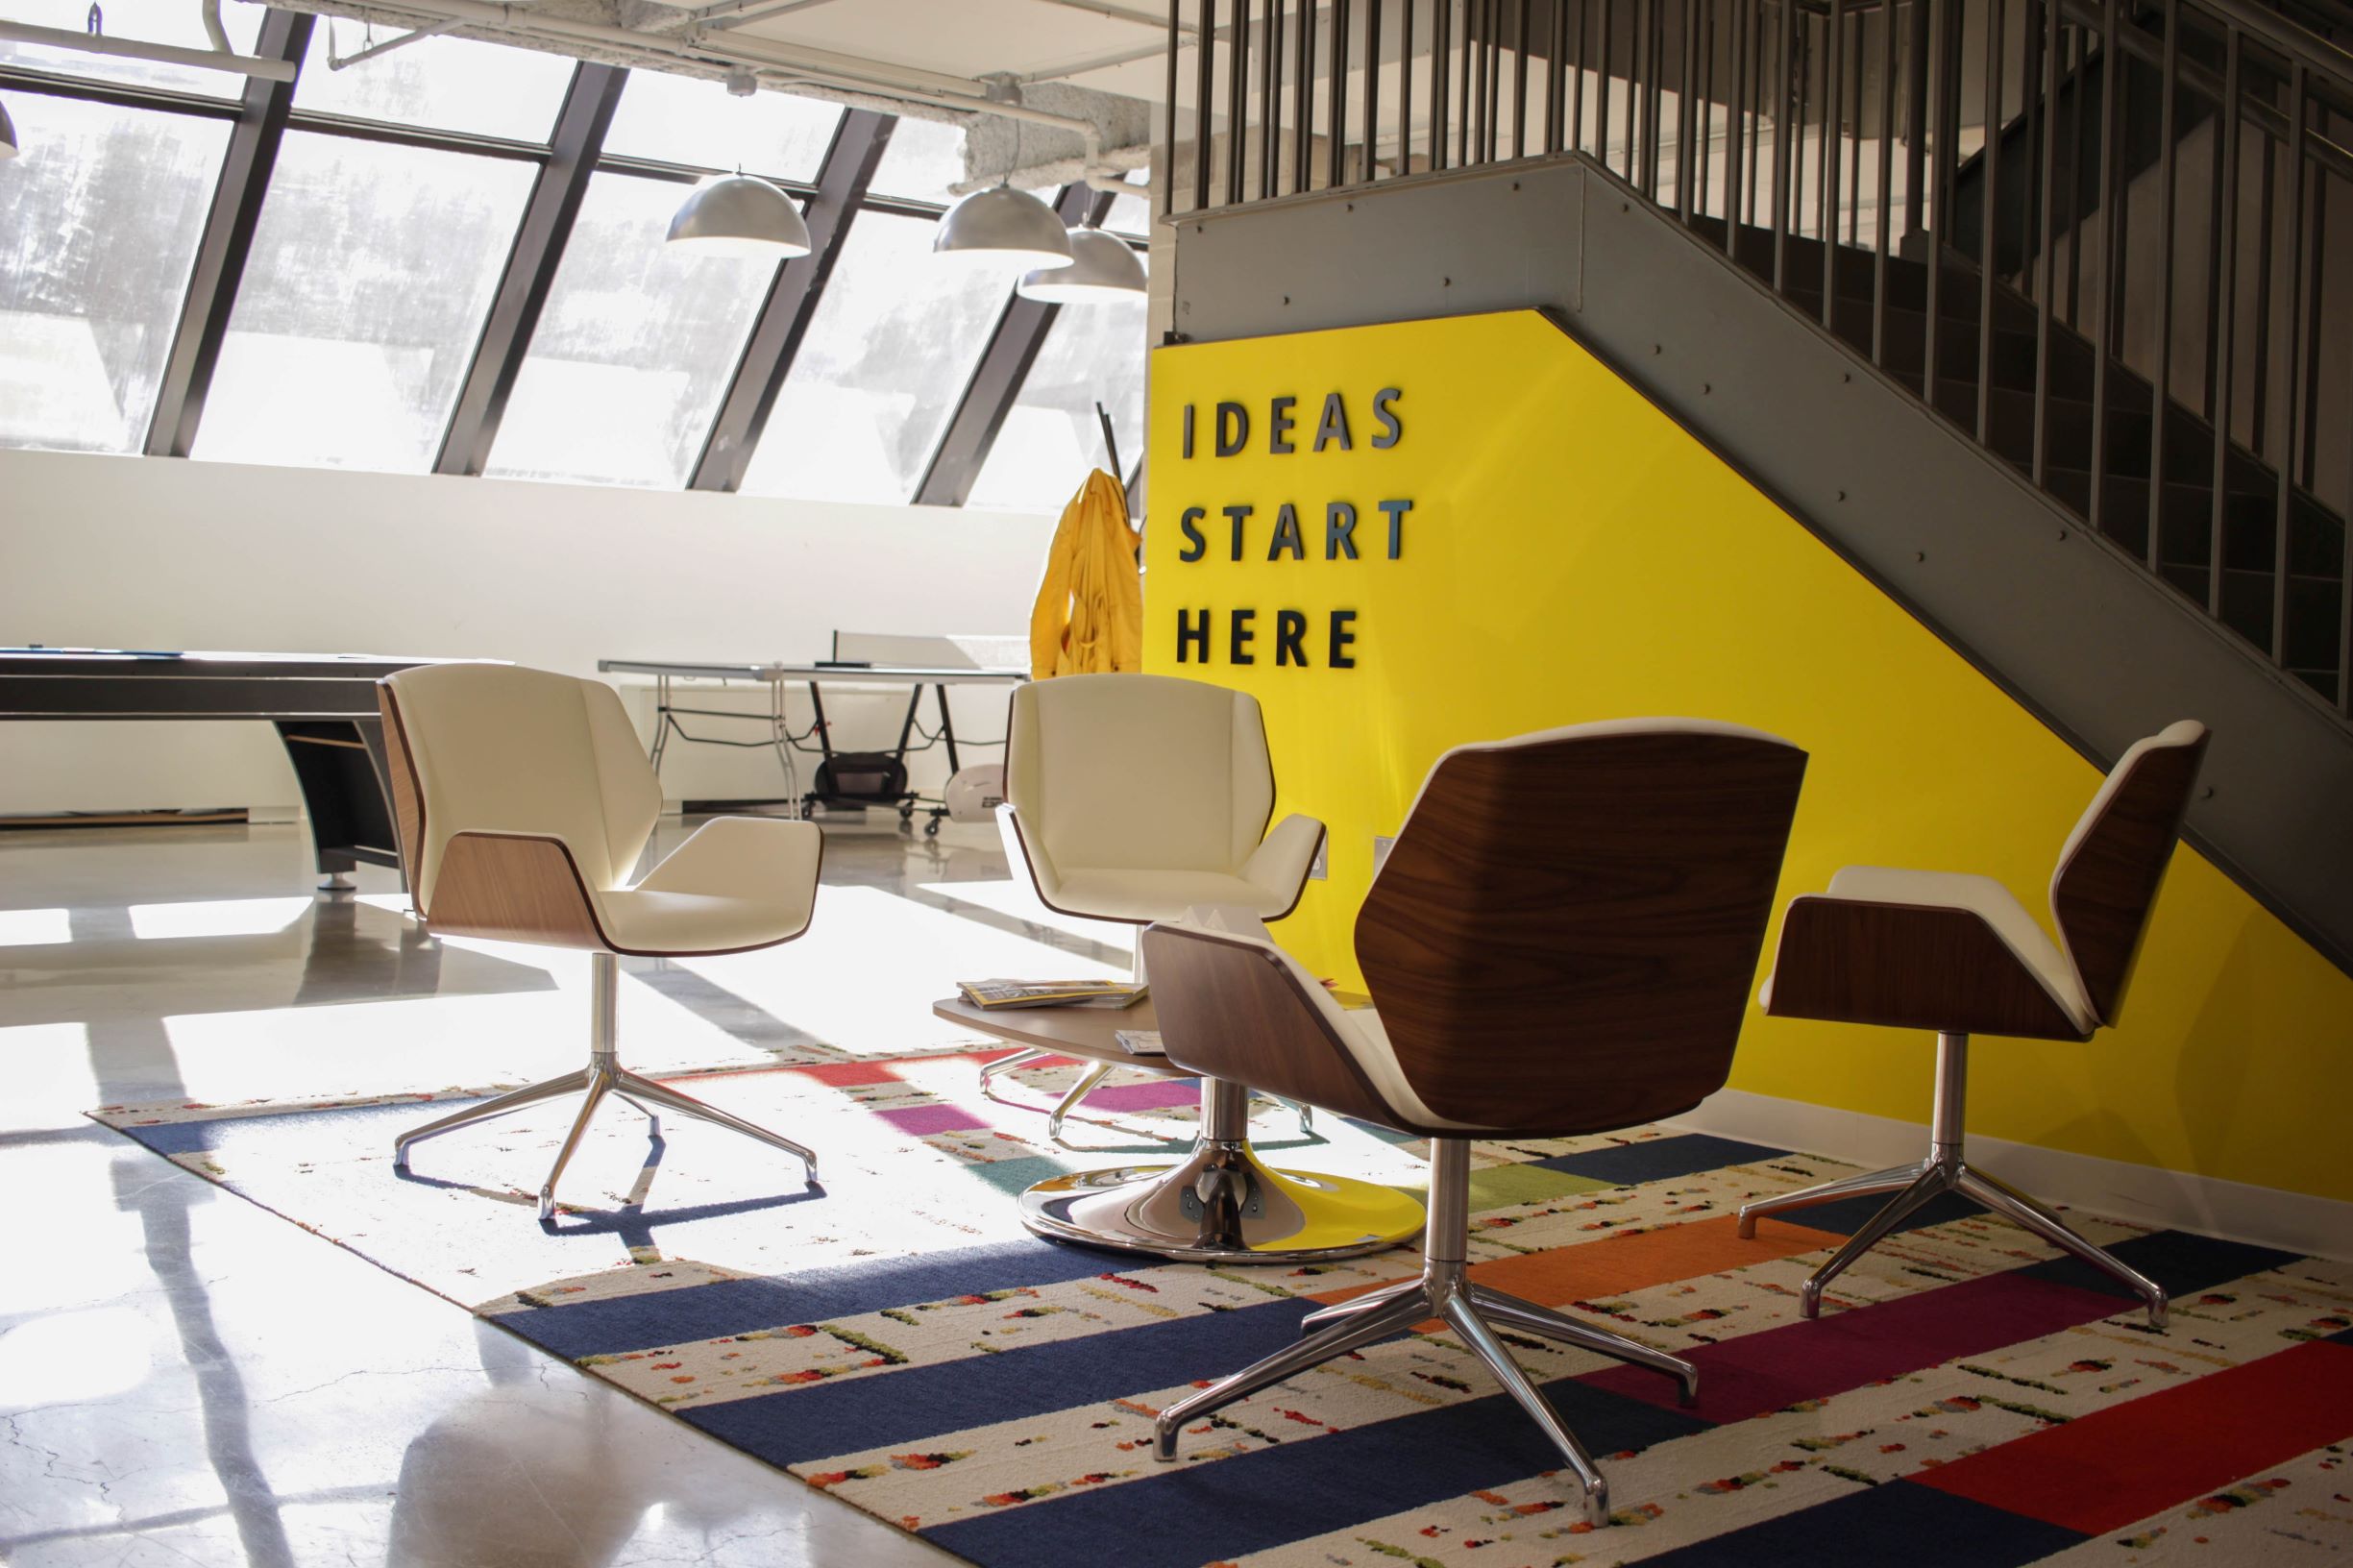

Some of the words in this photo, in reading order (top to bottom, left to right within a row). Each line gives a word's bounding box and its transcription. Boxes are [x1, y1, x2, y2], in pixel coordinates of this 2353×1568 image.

[1182, 386, 1403, 459] IDEAS
[1179, 499, 1413, 563] START
[1176, 608, 1358, 669] HERE
